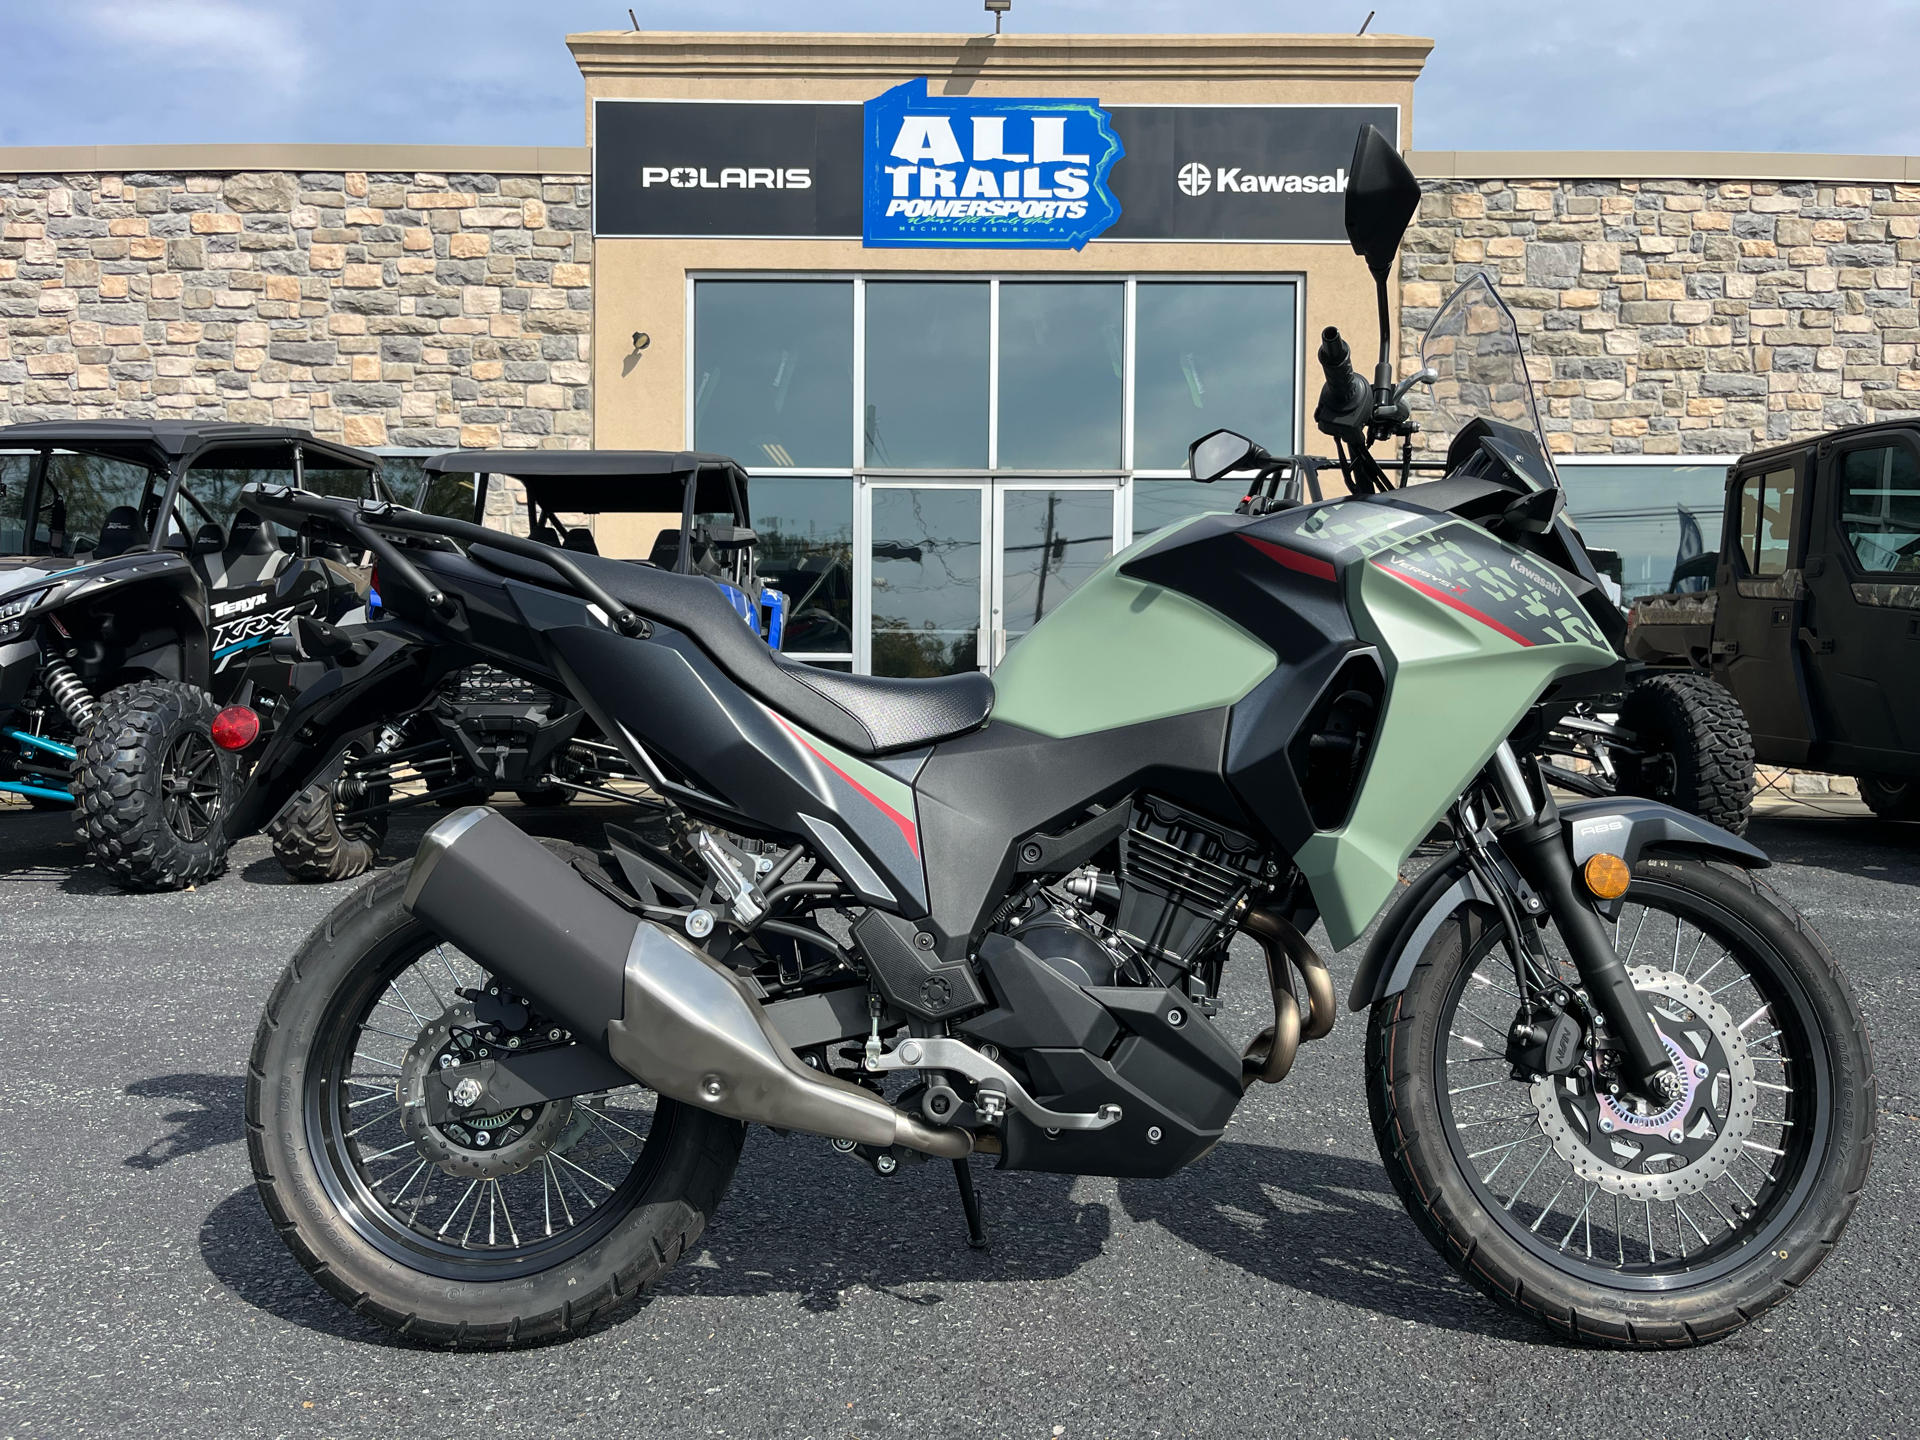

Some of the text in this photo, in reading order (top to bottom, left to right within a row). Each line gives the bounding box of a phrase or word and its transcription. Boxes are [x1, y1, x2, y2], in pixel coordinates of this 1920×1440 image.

[890, 116, 1090, 167] ALL
[642, 167, 812, 189] POLARIS
[885, 166, 1090, 199] TRAILS
[1217, 168, 1349, 193] Kawasak
[885, 199, 1089, 219] POWERSPORTS
[1390, 554, 1469, 596] VERSYS-X
[1509, 557, 1562, 597] Kawasaki
[210, 593, 267, 617] TERYX
[1651, 611, 1696, 620] RANGER
[1581, 821, 1623, 836] ABS
[1835, 1032, 1854, 1130] 100/90-19
[292, 1172, 354, 1256] 130/80-17
